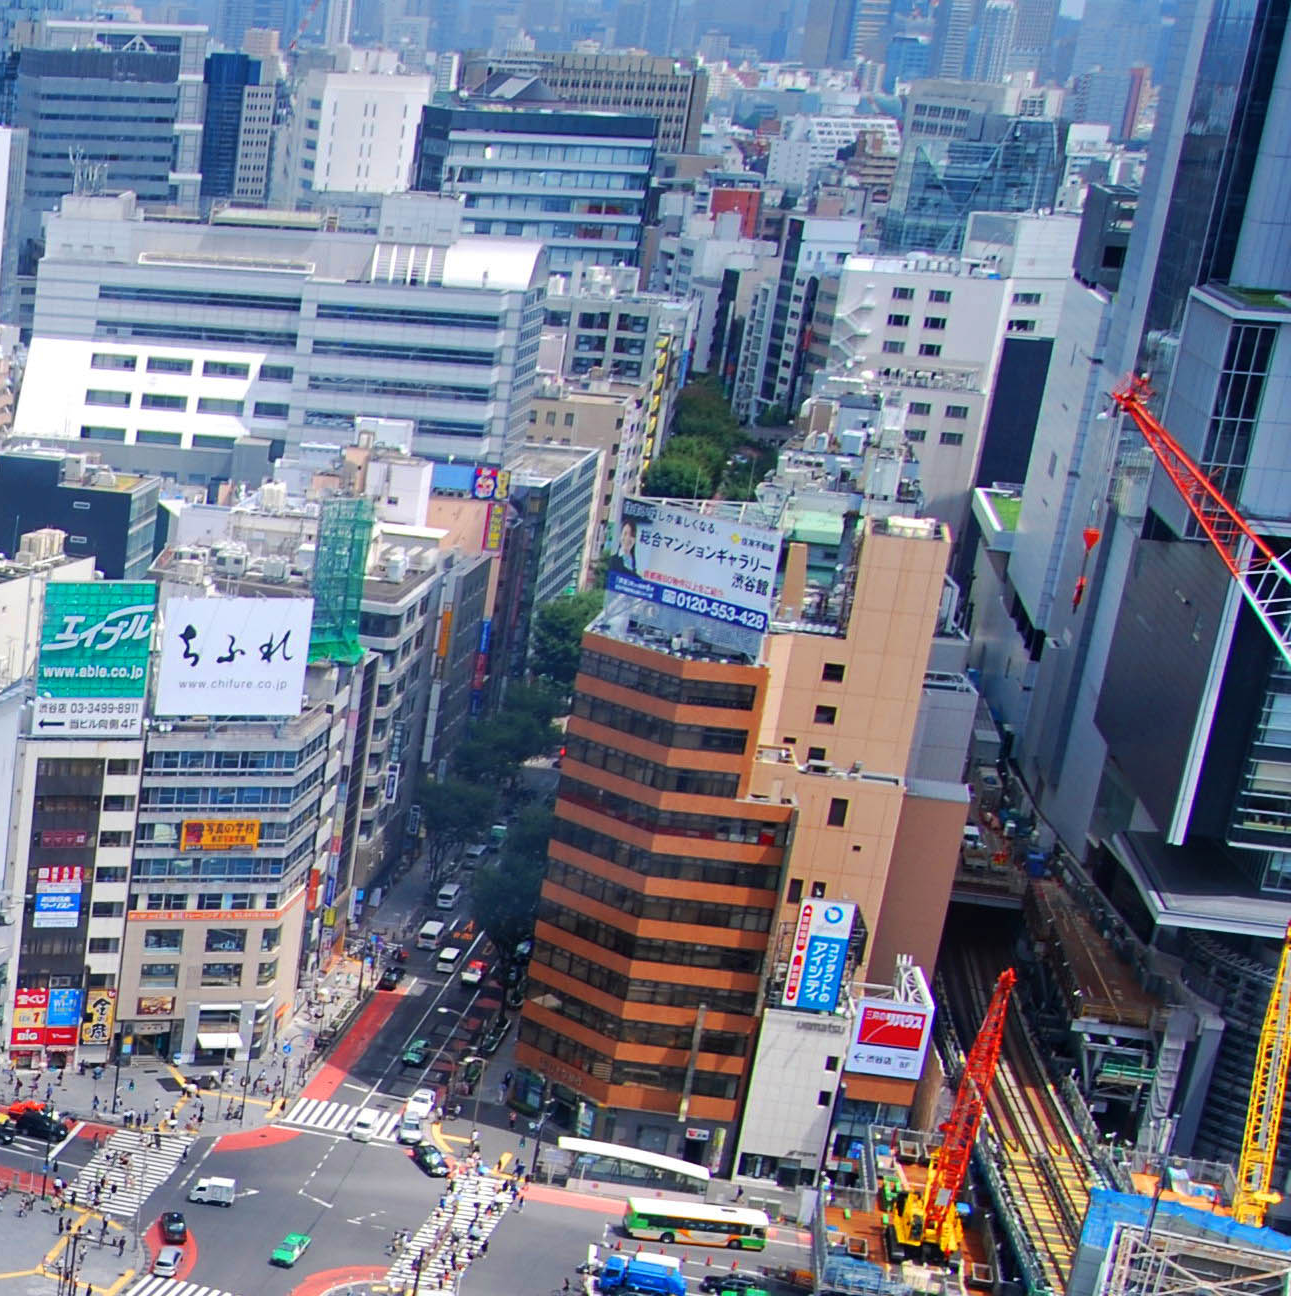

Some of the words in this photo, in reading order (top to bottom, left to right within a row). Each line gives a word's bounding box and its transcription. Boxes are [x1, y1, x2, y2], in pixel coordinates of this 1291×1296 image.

[640, 530, 772, 573] 総合マンションギャラリー
[42, 604, 156, 650] エイブル
[676, 592, 765, 630] 0120-553-428
[179, 624, 294, 667] ちふれ
[43, 664, 144, 680] www.able.co.jp
[179, 678, 288, 691] www.chifure.co.jp
[70, 702, 139, 714] 03-3499-8911
